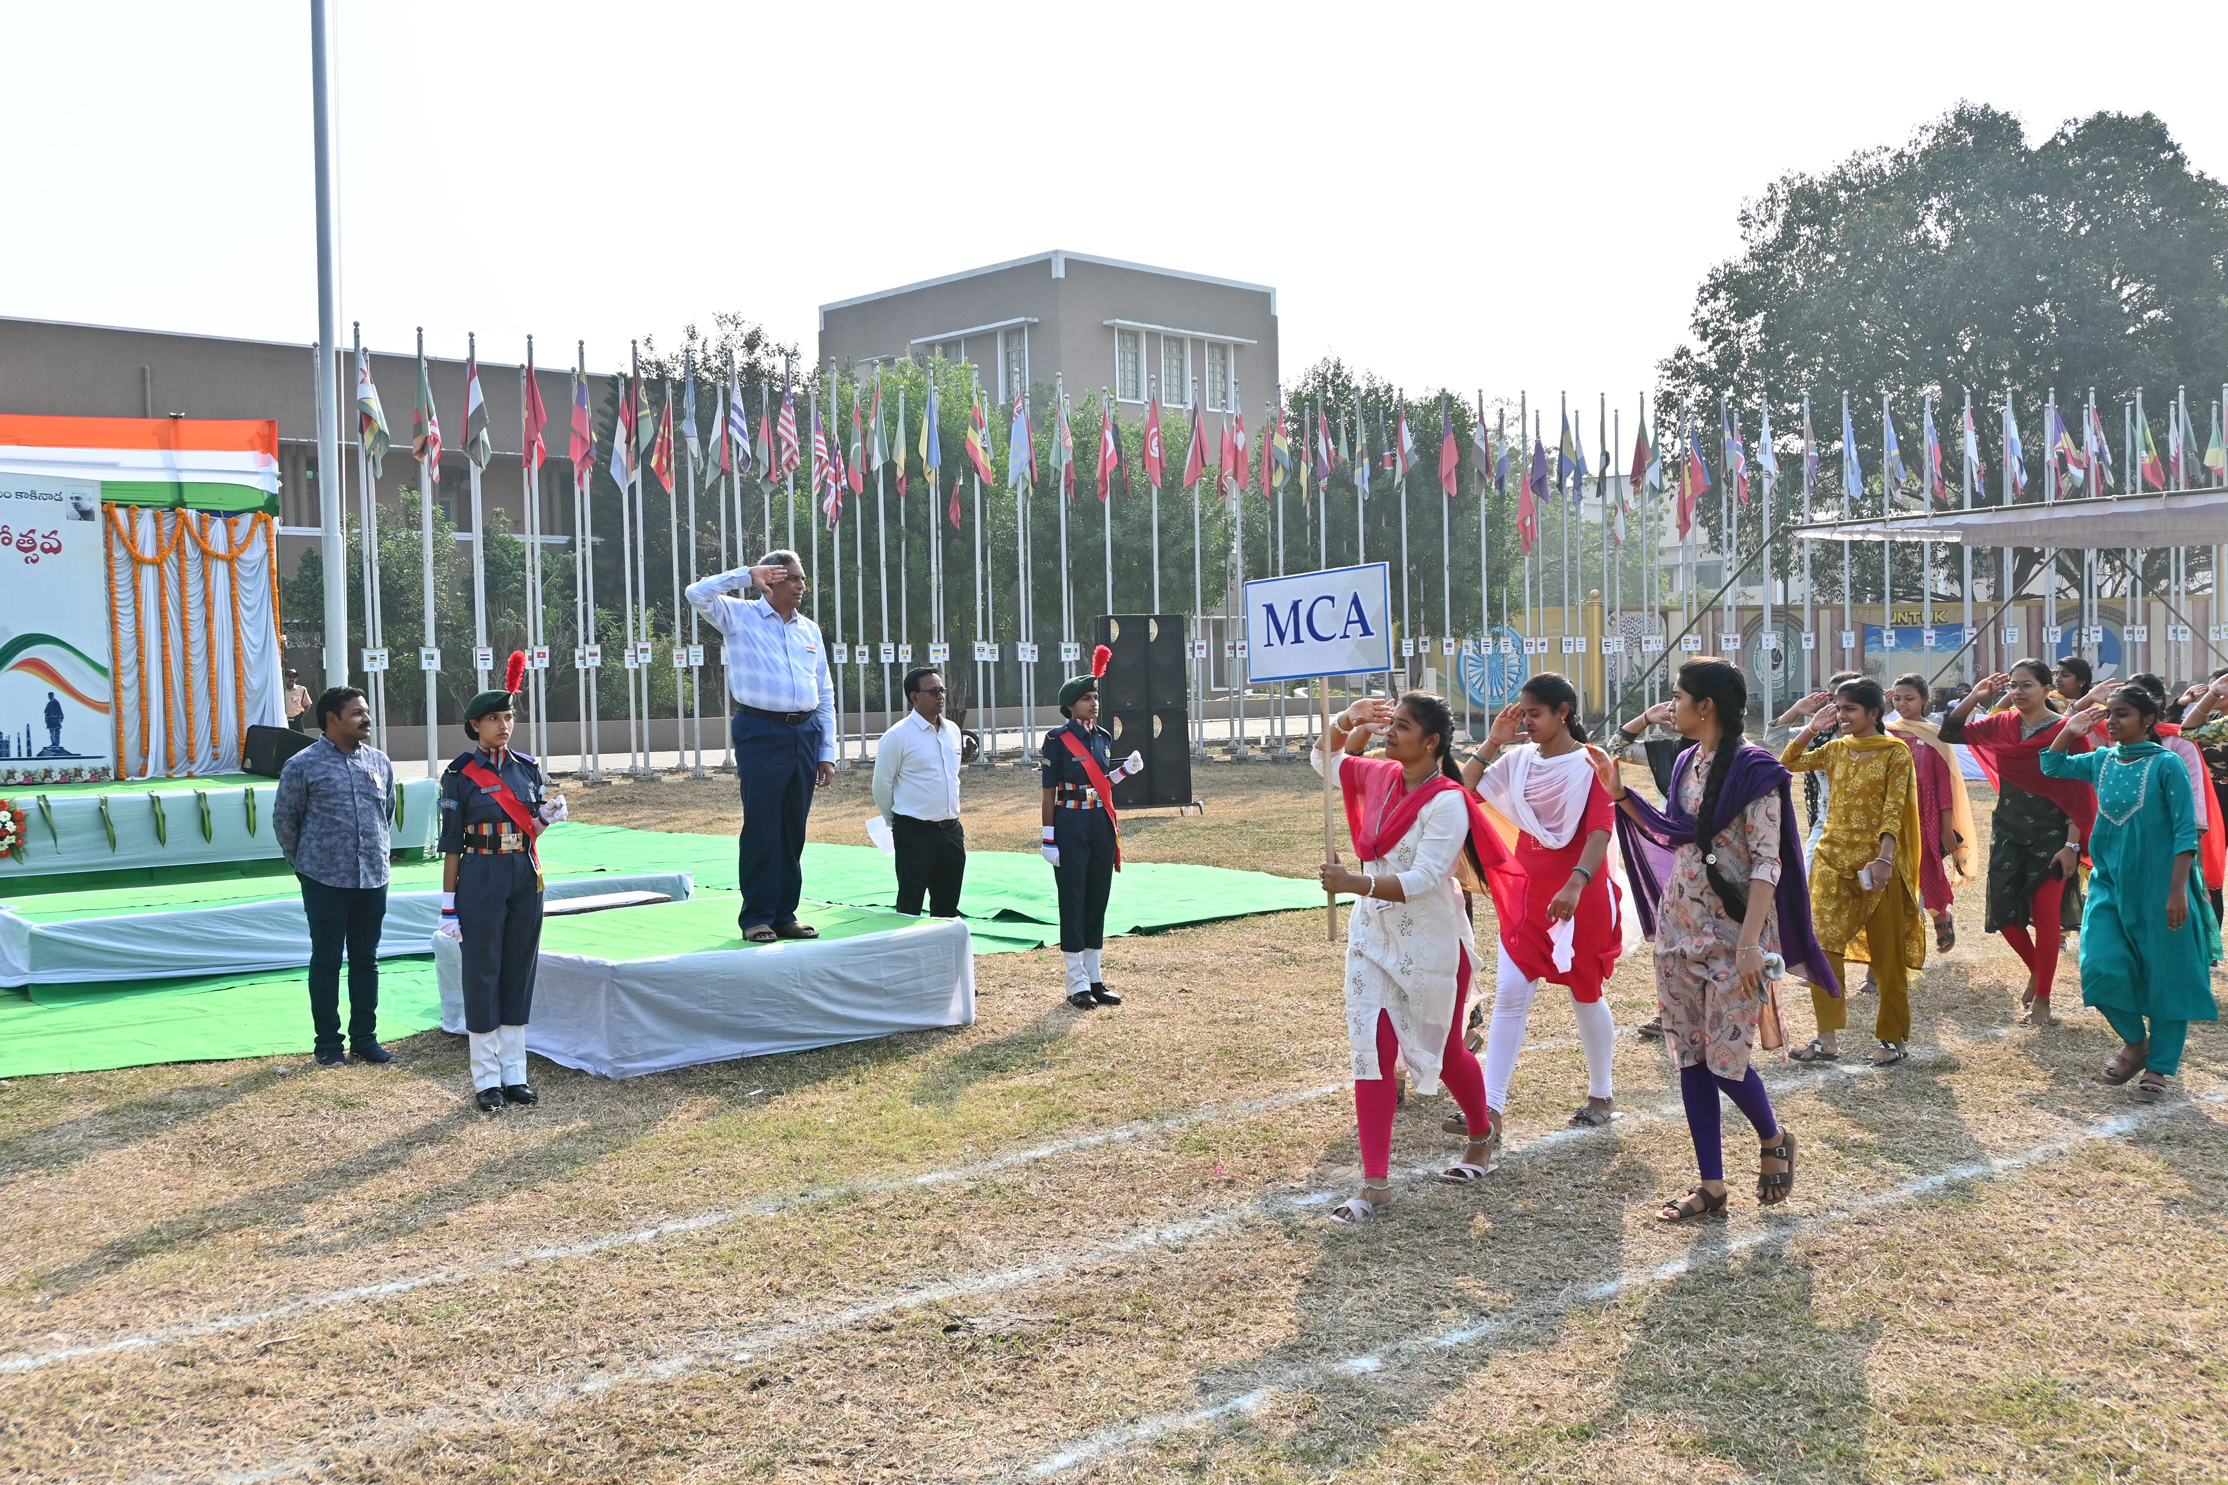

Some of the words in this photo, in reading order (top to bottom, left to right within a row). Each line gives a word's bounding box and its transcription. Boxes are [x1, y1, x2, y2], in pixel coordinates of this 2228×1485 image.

[15, 490, 63, 502] కాకినాడ
[1262, 591, 1375, 648] MCA
[440, 800, 455, 808] NCC
